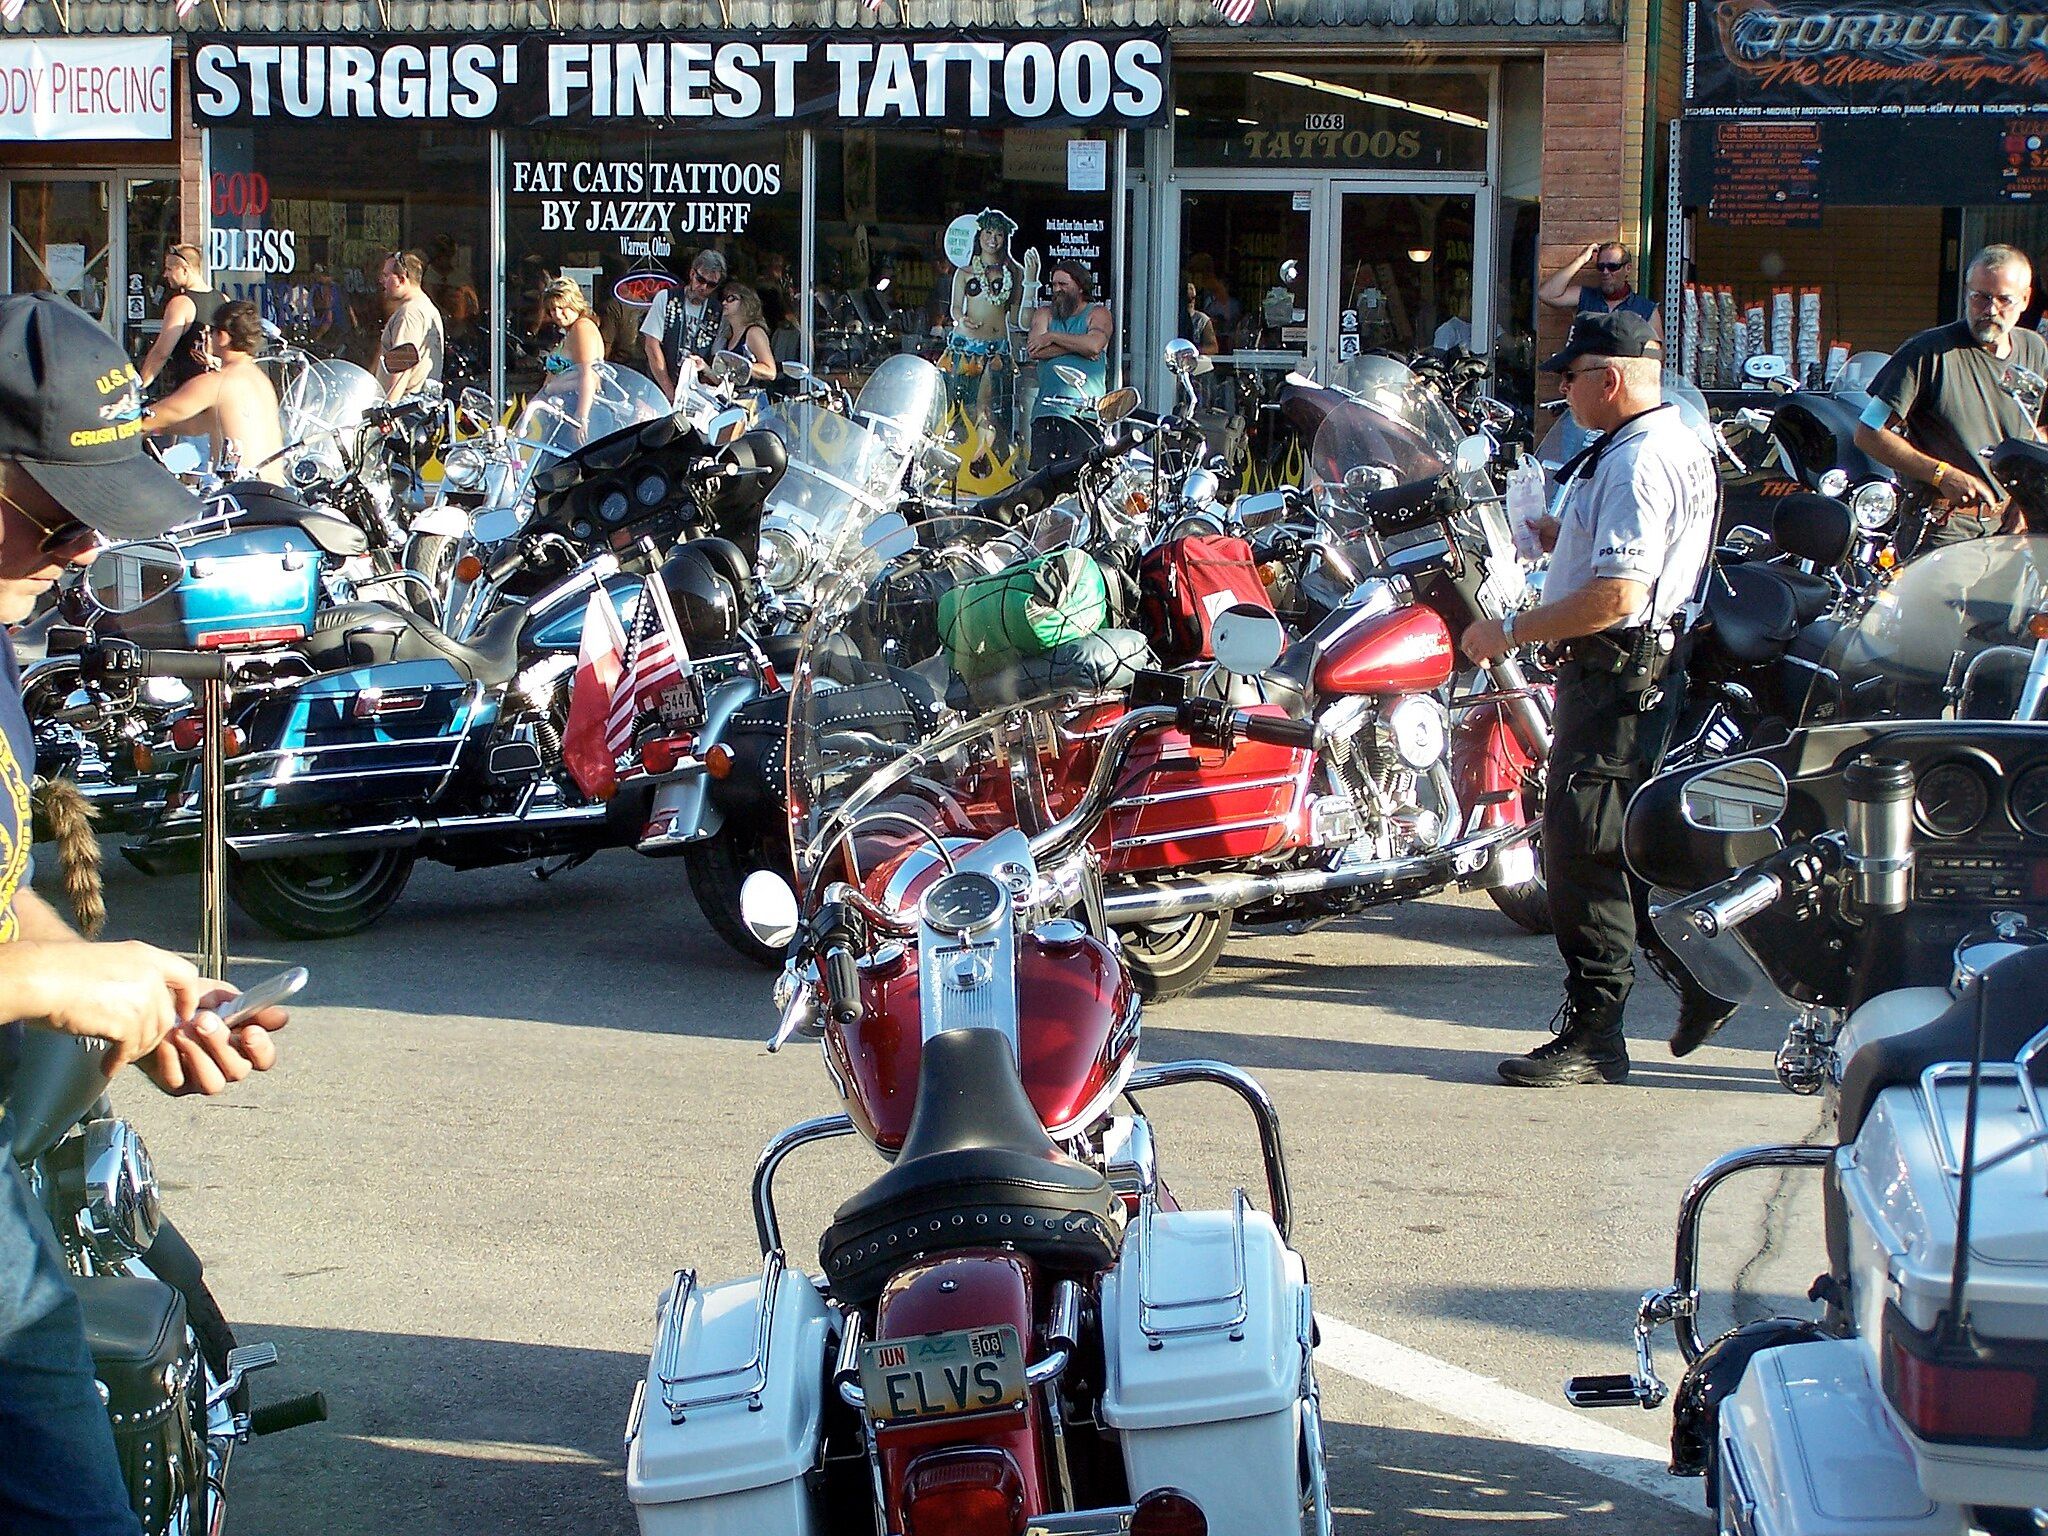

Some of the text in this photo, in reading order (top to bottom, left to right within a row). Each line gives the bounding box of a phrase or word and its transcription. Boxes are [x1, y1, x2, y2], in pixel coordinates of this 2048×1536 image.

[1750, 12, 2048, 52] TURBULAT
[195, 39, 1164, 118] STURGIS' FINEST TATTOOS
[1754, 56, 1821, 90] The
[1823, 54, 1938, 87] Ultimate
[1932, 55, 2014, 90] Torque
[1305, 113, 1345, 130] 1068
[1715, 106, 1737, 116] CYCLE
[1801, 106, 1849, 115] MOTORCYCLE
[1243, 129, 1422, 159] TATTOOS
[210, 170, 270, 217] GOD
[513, 161, 781, 195] FAT CATS TATTOOS
[541, 200, 751, 233] BY JAZZY JEFF
[209, 228, 296, 274] BLESS
[620, 236, 671, 257] Warren, Ohio
[1599, 546, 1645, 558] POLICE
[878, 1346, 906, 1368] JUN
[971, 1336, 1000, 1358] JUN 08
[885, 1361, 1004, 1418] ELVS
